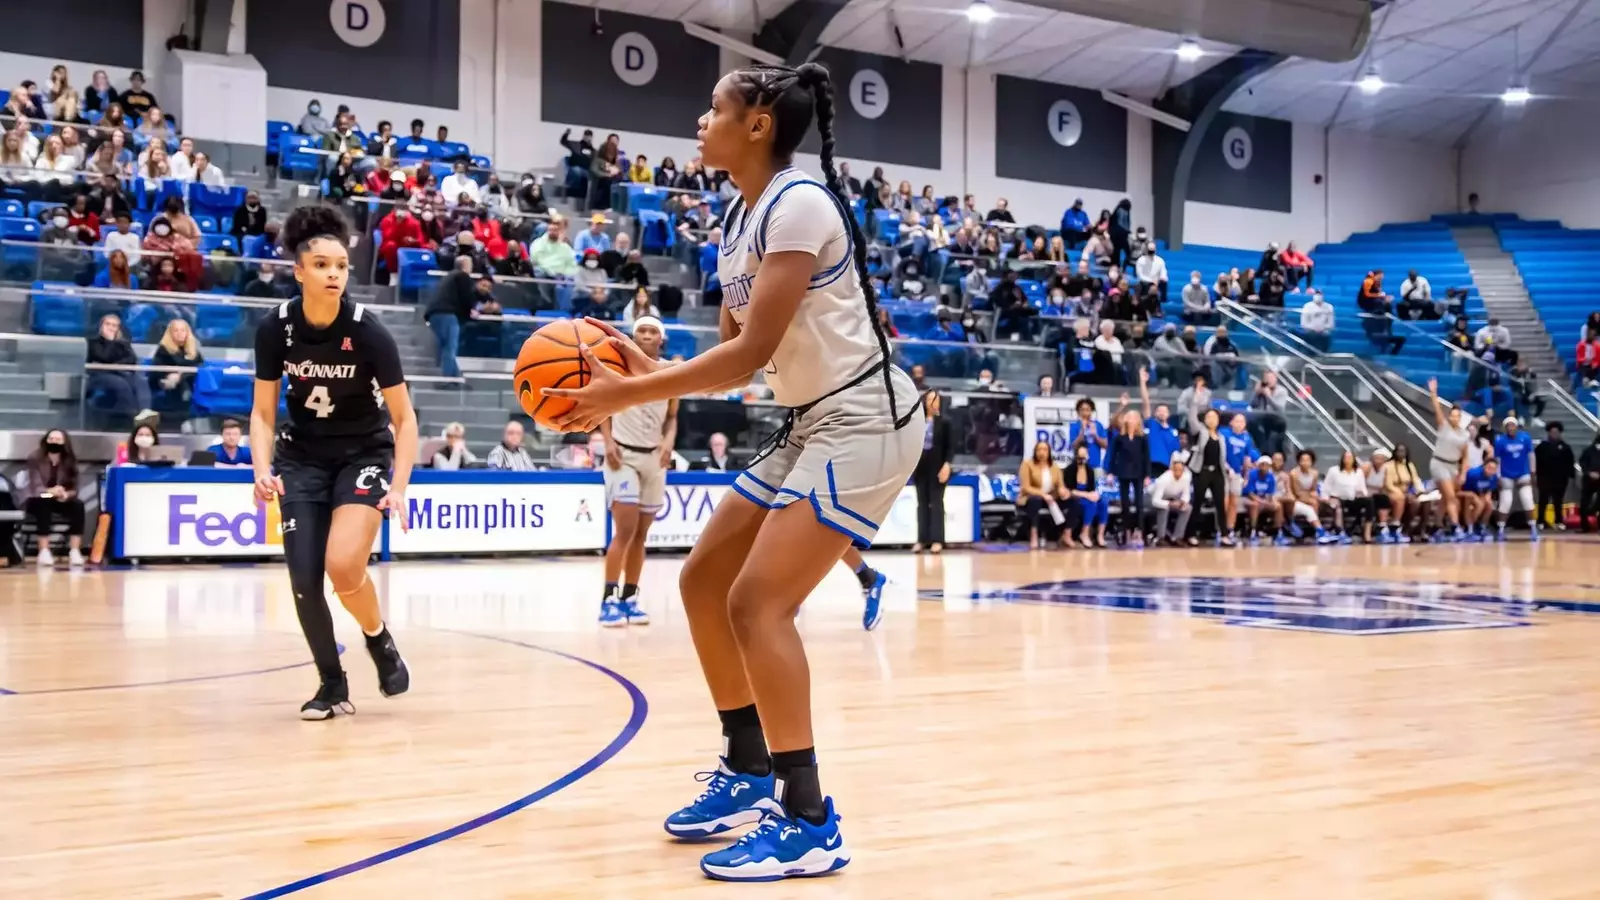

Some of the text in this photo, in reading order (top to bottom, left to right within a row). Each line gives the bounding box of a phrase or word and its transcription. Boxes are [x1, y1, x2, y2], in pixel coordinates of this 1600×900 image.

[346, 2, 369, 30] D
[625, 45, 644, 71] D
[861, 81, 877, 106] E
[1058, 111, 1071, 133] F
[1230, 138, 1245, 159] G
[283, 359, 357, 379] CINCINNATI
[304, 385, 336, 418] 4
[408, 498, 544, 535] Memphis
